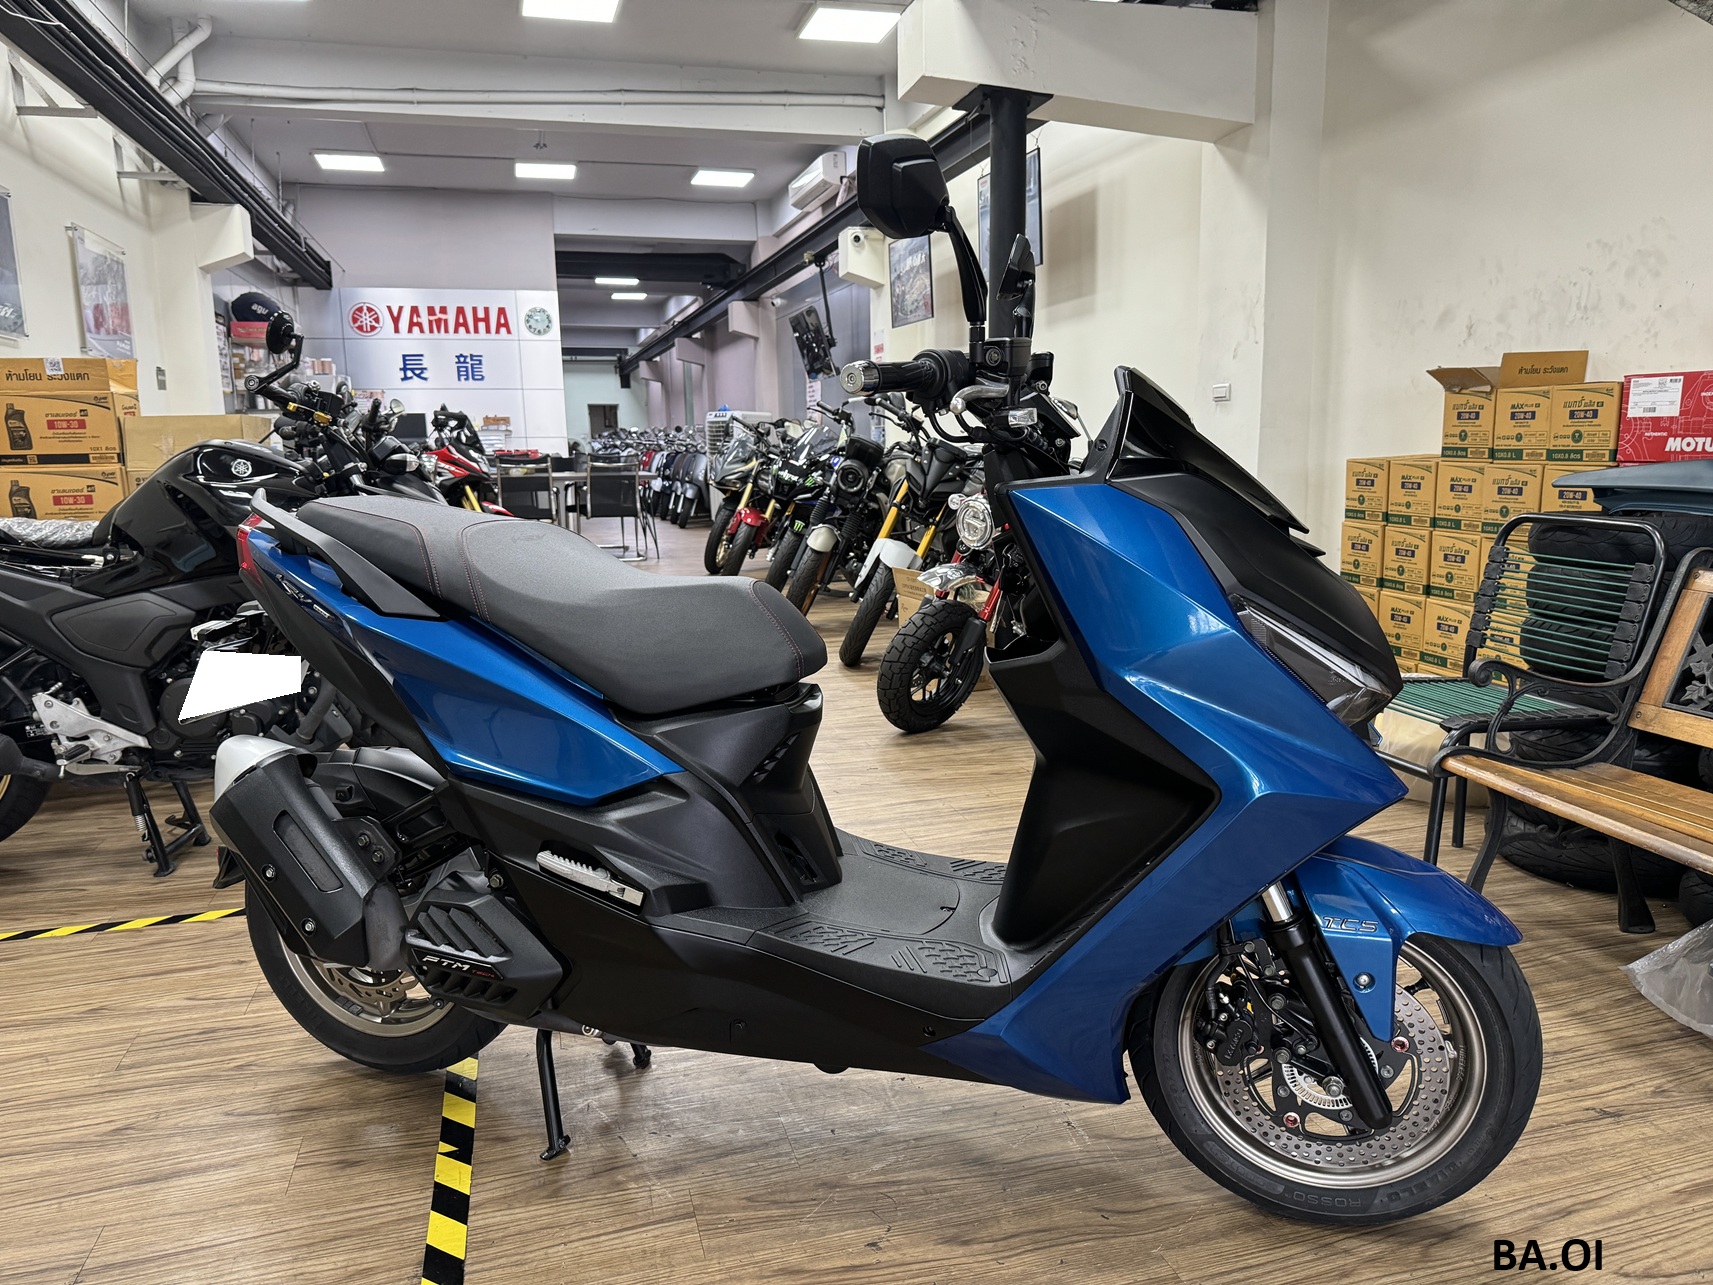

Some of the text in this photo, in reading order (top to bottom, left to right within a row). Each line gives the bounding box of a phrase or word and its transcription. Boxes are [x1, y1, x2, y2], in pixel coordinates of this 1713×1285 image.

[386, 305, 512, 334] YAMAHA
[399, 353, 485, 382] 長龍
[5, 369, 90, 381] ห้ามโยน ระวงแตก
[1514, 412, 1532, 420] 20W-40
[54, 420, 79, 429] 10W-30
[1665, 437, 1713, 452] MOTU
[1501, 487, 1519, 495] 20W-40
[1562, 491, 1582, 499] 20W-40
[60, 496, 86, 505] 10W-30
[1440, 624, 1455, 632] 20W-40
[1323, 916, 1379, 933] TCS
[1293, 1191, 1362, 1208] ROSSO
